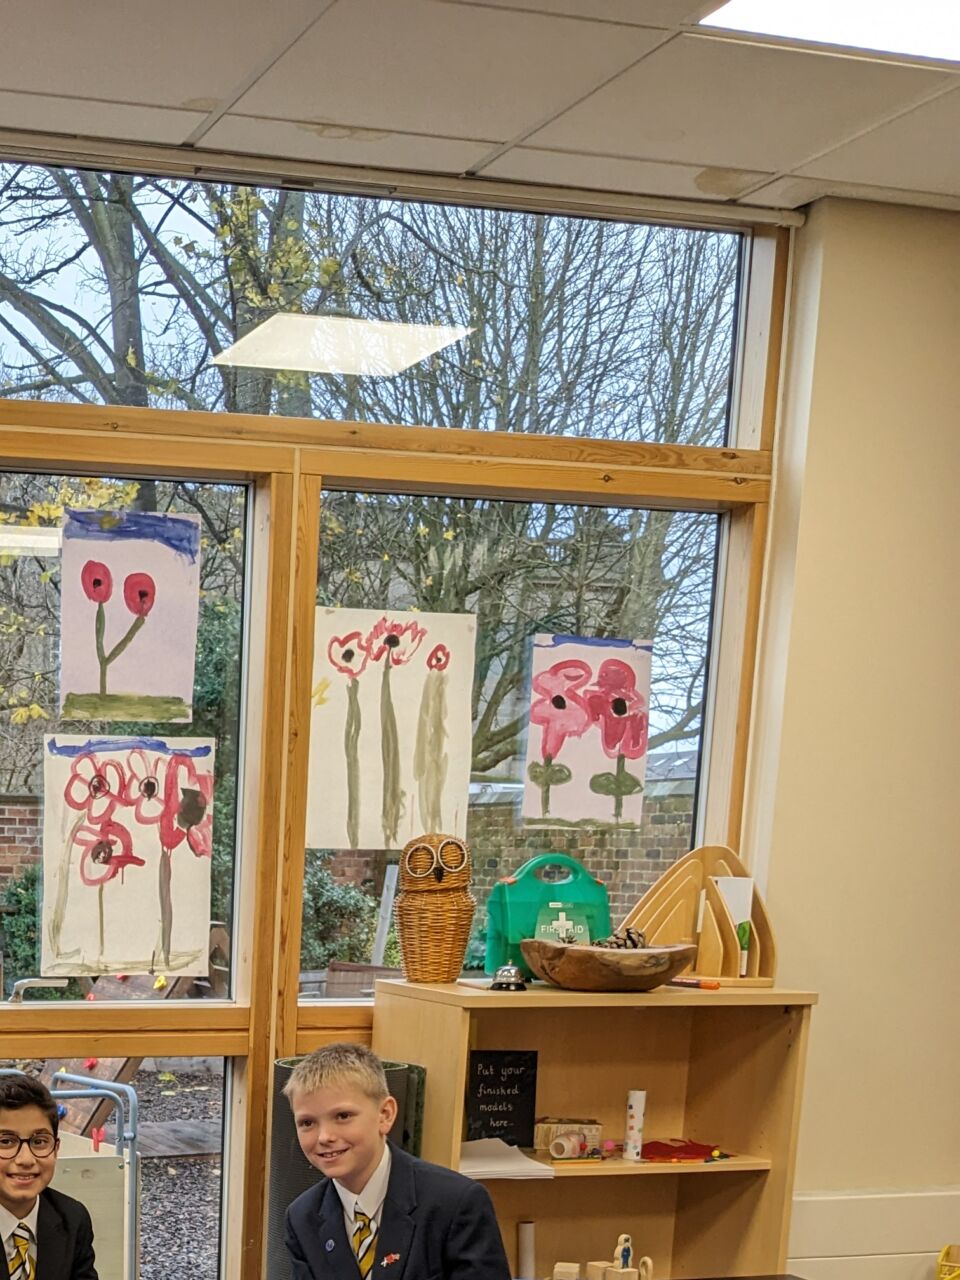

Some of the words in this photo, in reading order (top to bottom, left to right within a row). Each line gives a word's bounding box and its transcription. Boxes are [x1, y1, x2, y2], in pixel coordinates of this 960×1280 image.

[541, 925, 565, 933] FIRS
[568, 925, 584, 933] AID
[477, 1063, 494, 1075] Put
[501, 1066, 525, 1081] your
[477, 1085, 519, 1097] finished
[479, 1102, 513, 1112] models
